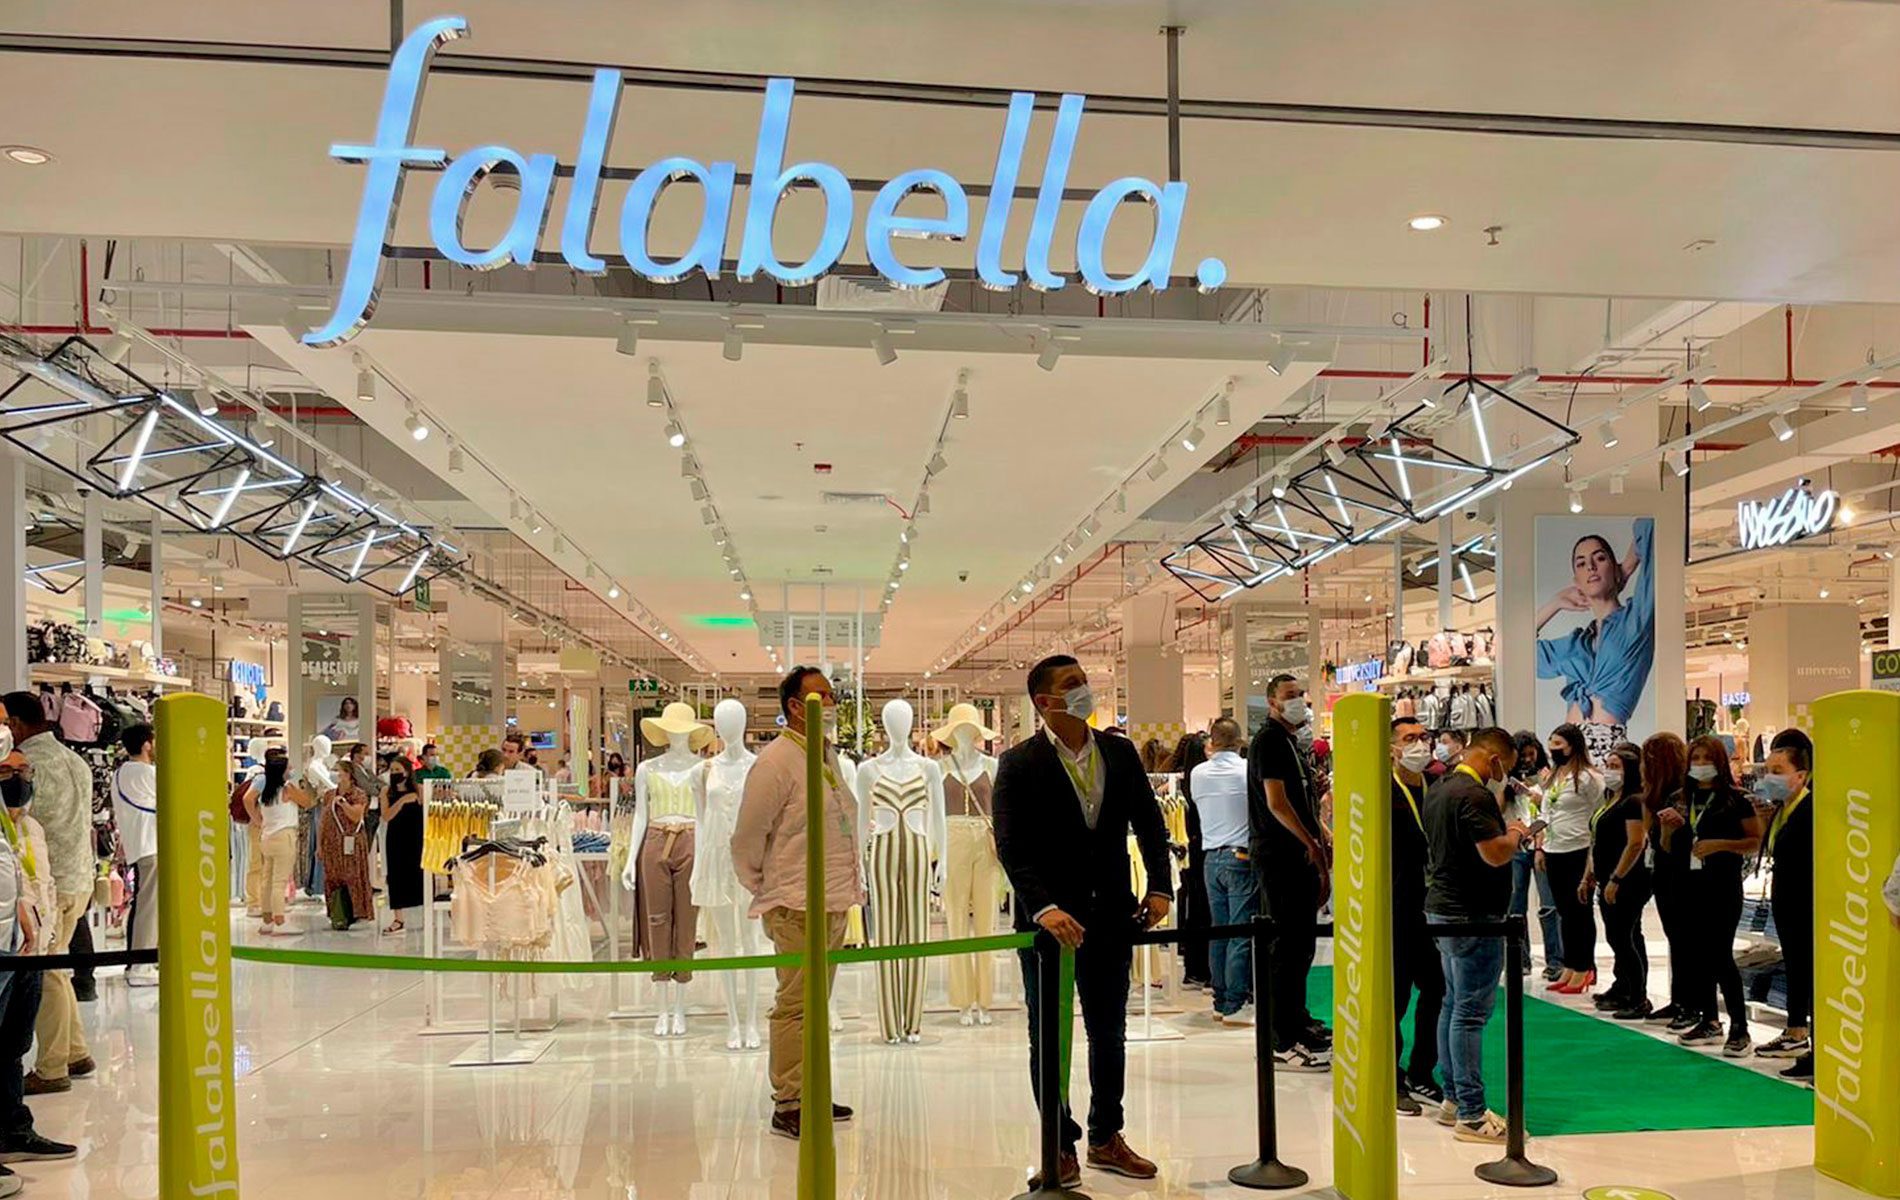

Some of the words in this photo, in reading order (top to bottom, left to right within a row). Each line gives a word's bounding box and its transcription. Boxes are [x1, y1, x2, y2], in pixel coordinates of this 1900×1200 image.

[189, 809, 238, 1198] falabella.com
[1334, 792, 1365, 1155] falabella.com
[1815, 788, 1875, 1143] falabella.com
